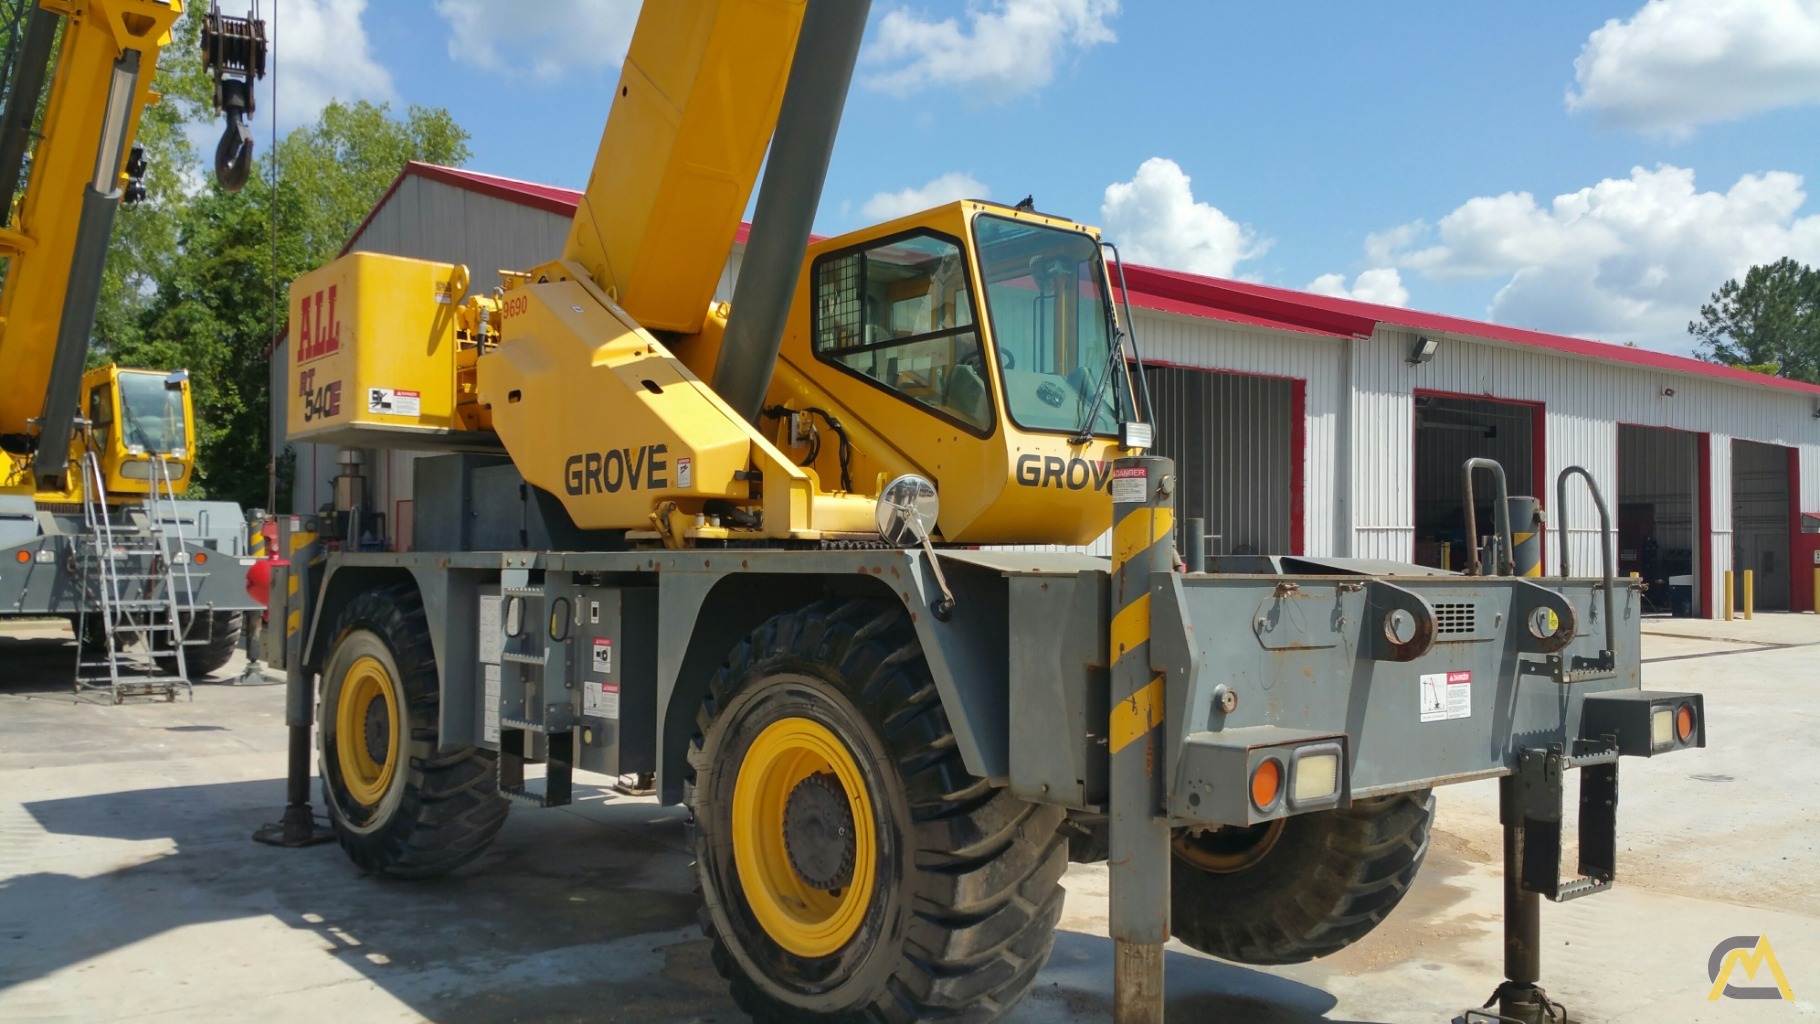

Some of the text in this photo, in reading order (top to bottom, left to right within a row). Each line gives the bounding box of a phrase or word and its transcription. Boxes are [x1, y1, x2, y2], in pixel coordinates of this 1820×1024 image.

[297, 284, 340, 362] ALL
[503, 296, 527, 319] 9690
[299, 368, 315, 397] RT
[304, 380, 341, 422] 540E
[565, 444, 668, 496] GROVE
[1016, 454, 1112, 491] GROV
[1115, 469, 1145, 478] DANGER
